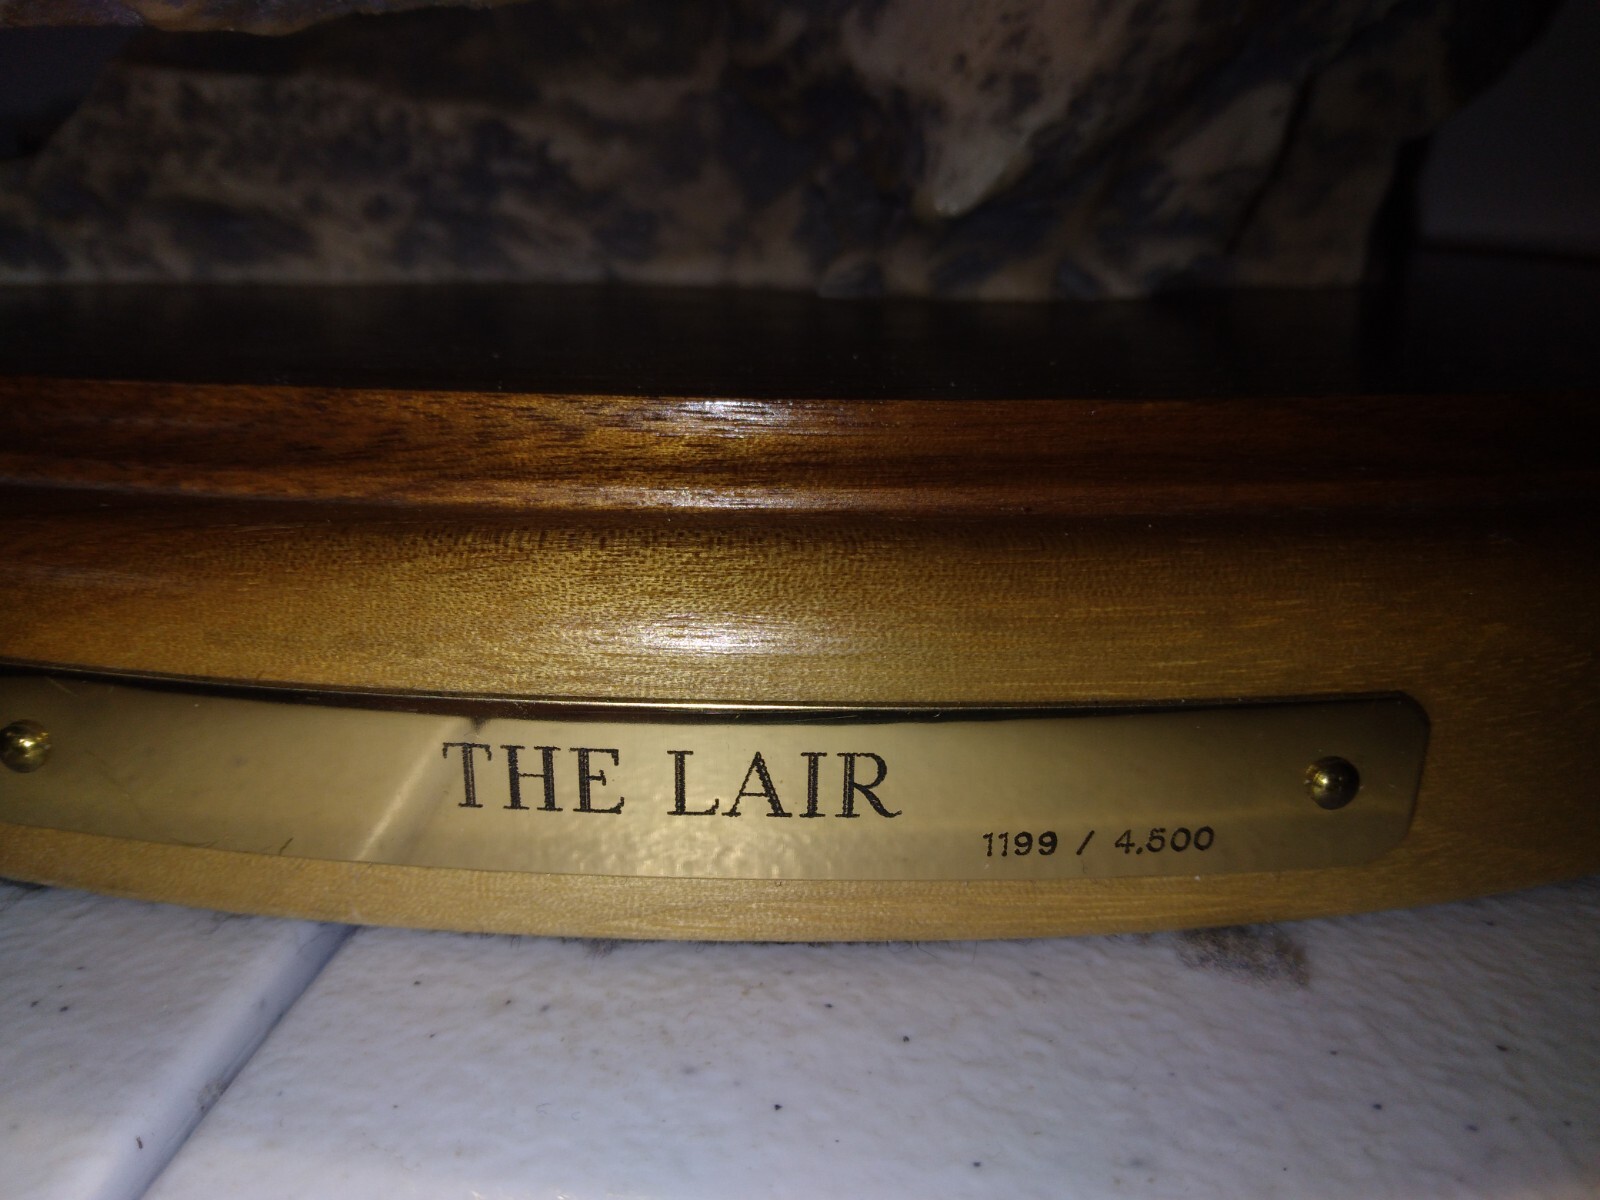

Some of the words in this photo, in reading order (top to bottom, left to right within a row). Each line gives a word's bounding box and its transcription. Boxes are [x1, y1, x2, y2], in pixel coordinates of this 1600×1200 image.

[442, 741, 625, 815] THE
[667, 750, 903, 818] LAIR
[983, 830, 1059, 857] 1199
[1076, 830, 1095, 856] /
